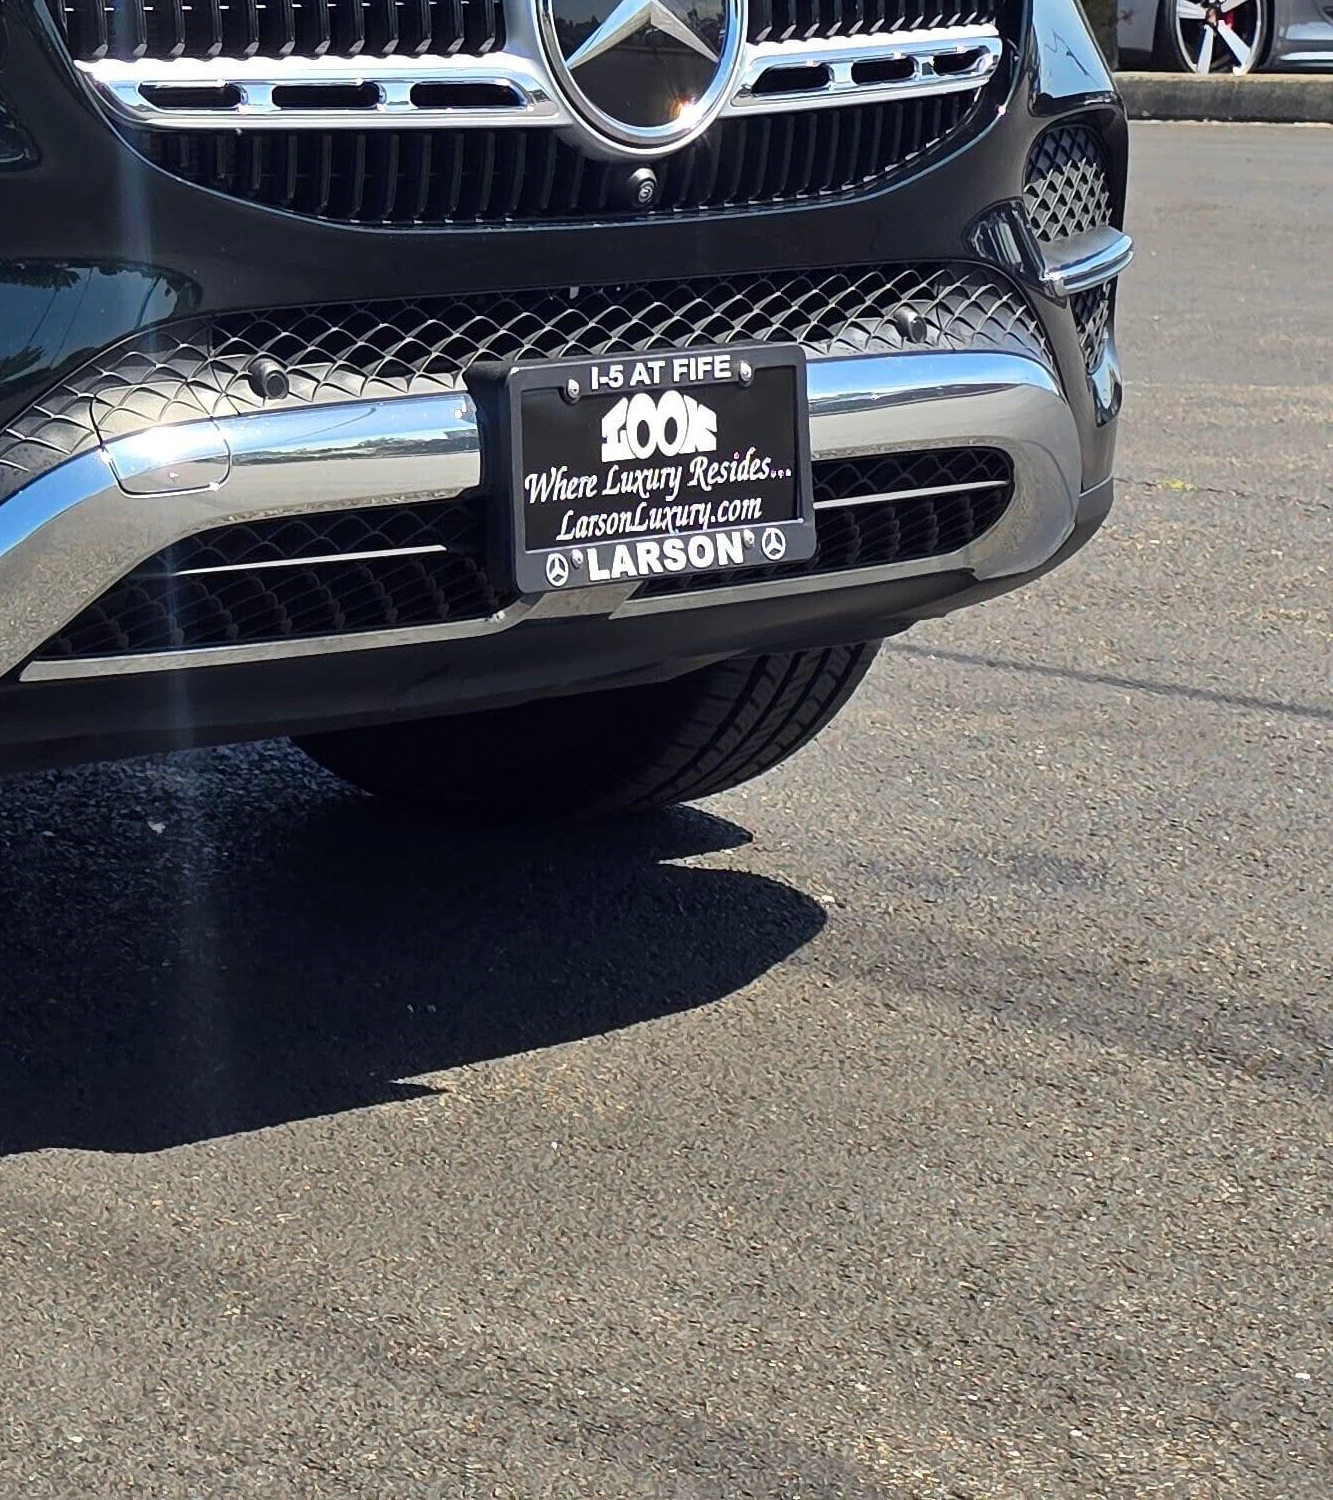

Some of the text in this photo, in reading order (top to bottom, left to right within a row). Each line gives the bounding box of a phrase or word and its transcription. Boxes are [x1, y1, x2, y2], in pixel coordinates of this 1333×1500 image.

[590, 354, 732, 391] I-5 AT FIFE
[524, 446, 792, 503] Where Luxury Resides...
[555, 497, 763, 541] LarsonLuxury.com
[586, 530, 745, 582] LARSON
